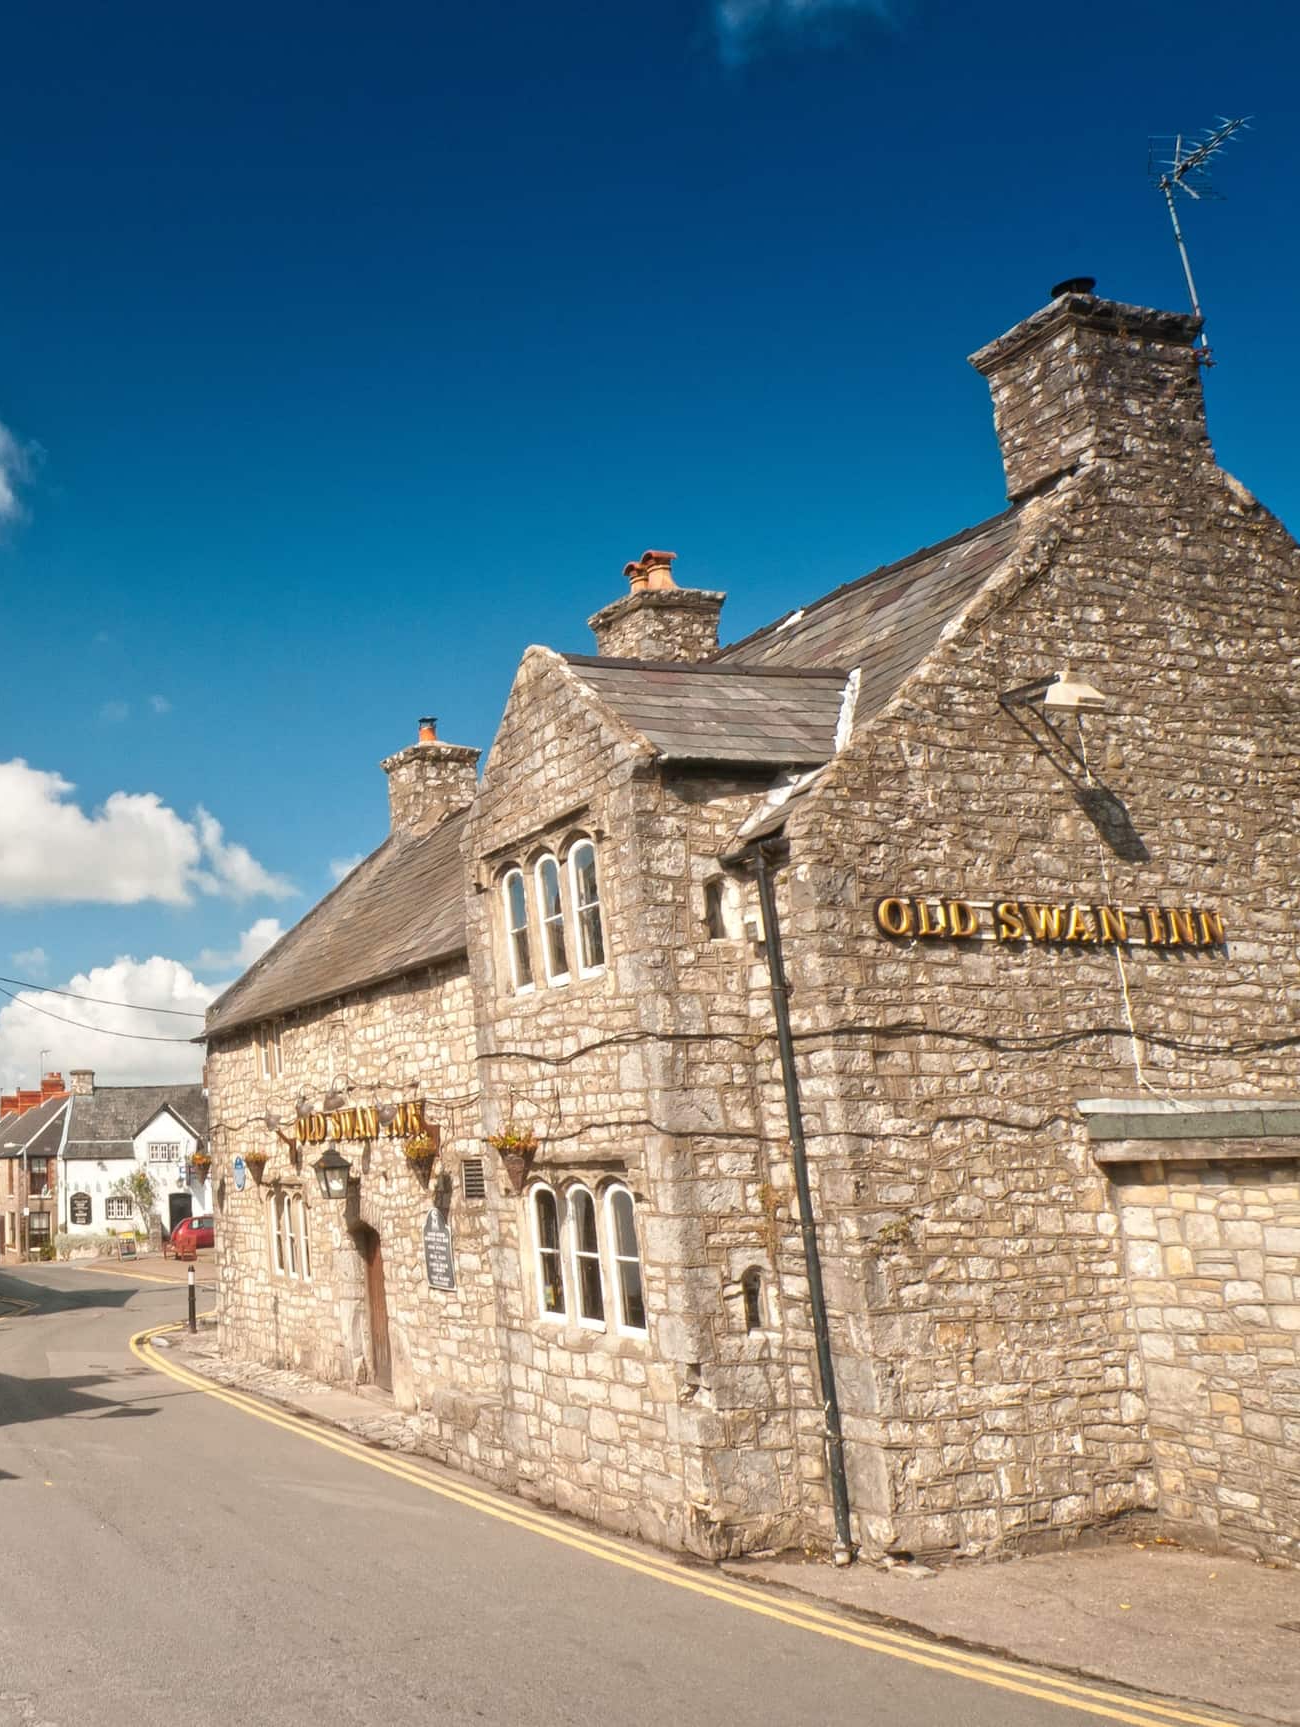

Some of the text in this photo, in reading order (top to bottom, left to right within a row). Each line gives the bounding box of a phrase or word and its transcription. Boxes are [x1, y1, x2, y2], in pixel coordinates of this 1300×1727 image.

[878, 896, 1225, 945] OLD SWAN INN
[297, 1112, 326, 1142] OLD
[331, 1106, 379, 1140] SWAN
